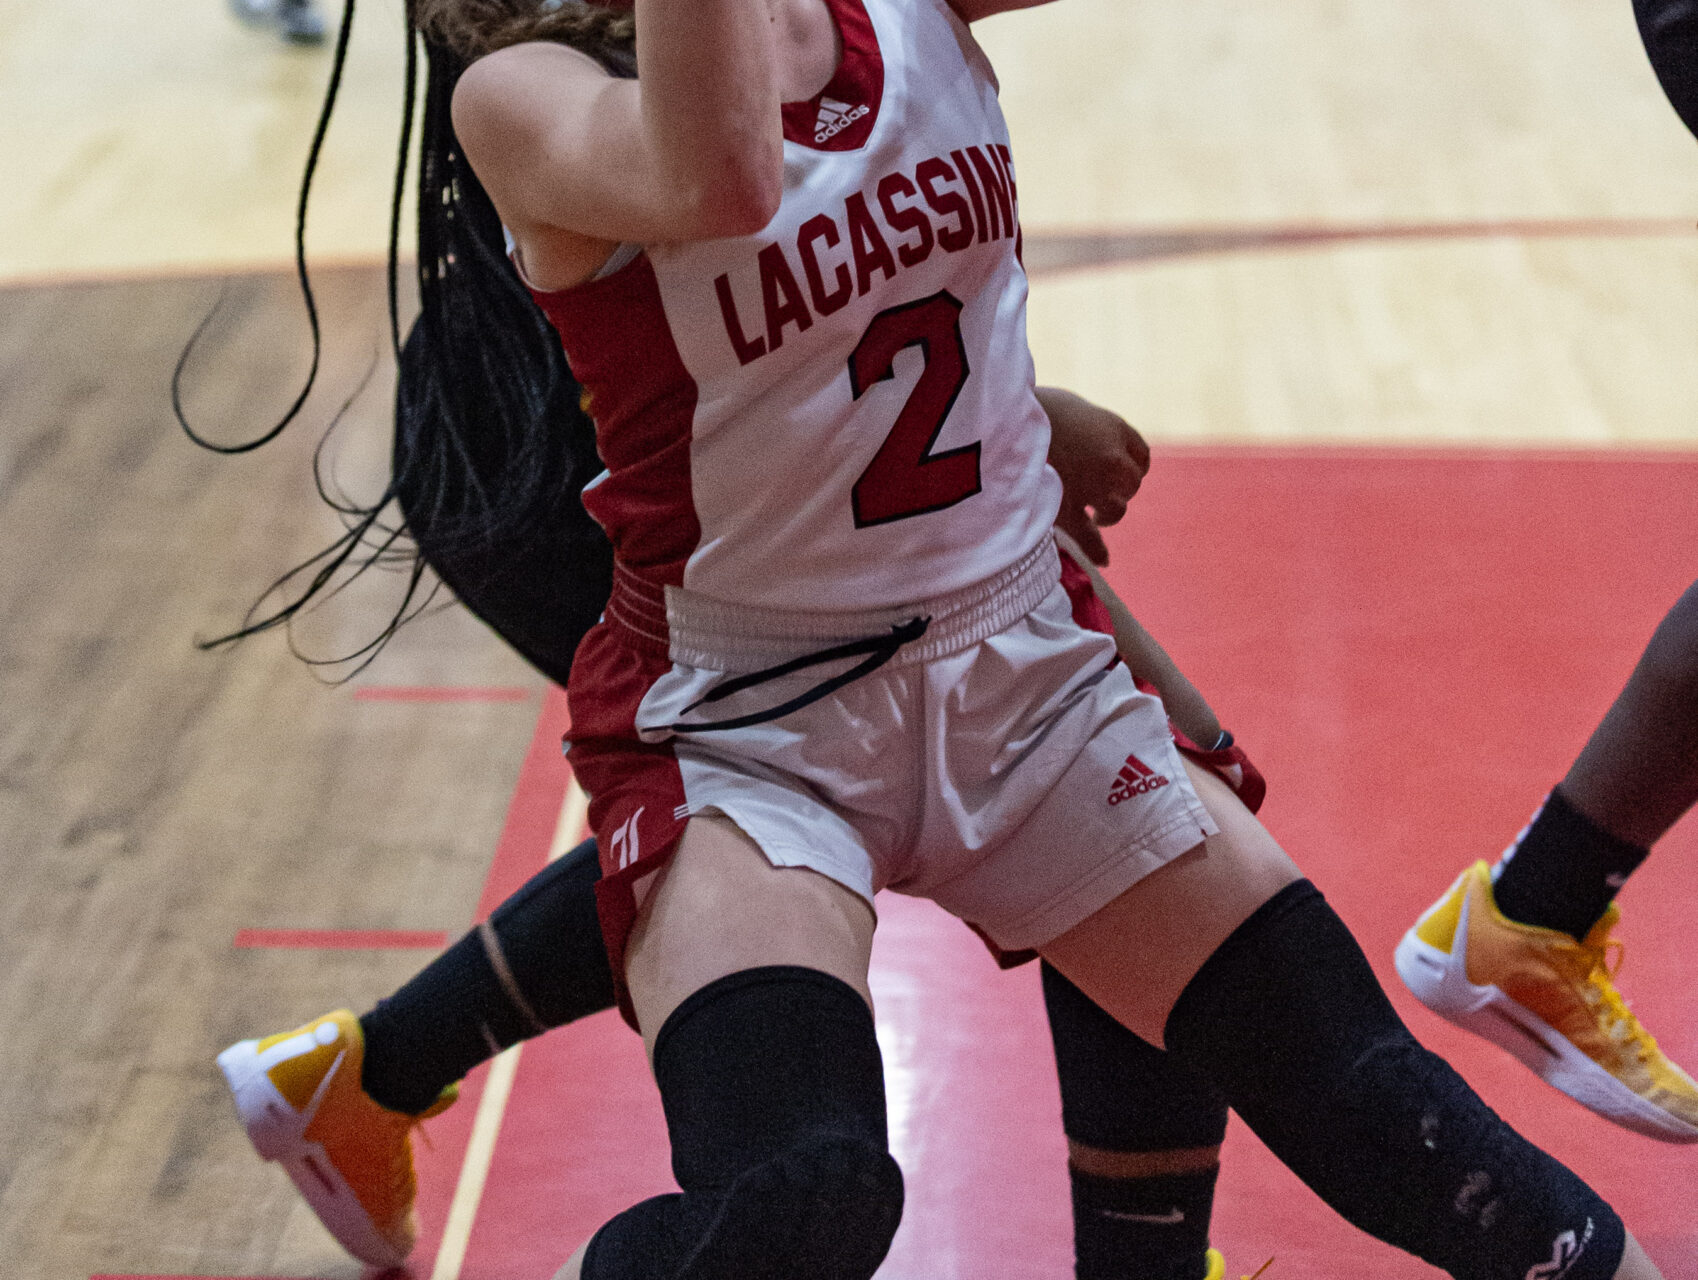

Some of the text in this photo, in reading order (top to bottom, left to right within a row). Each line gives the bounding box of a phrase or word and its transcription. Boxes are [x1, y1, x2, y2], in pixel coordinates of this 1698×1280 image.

[814, 104, 870, 143] adidas
[847, 288, 982, 530] 2
[1107, 775, 1170, 806] adidas
